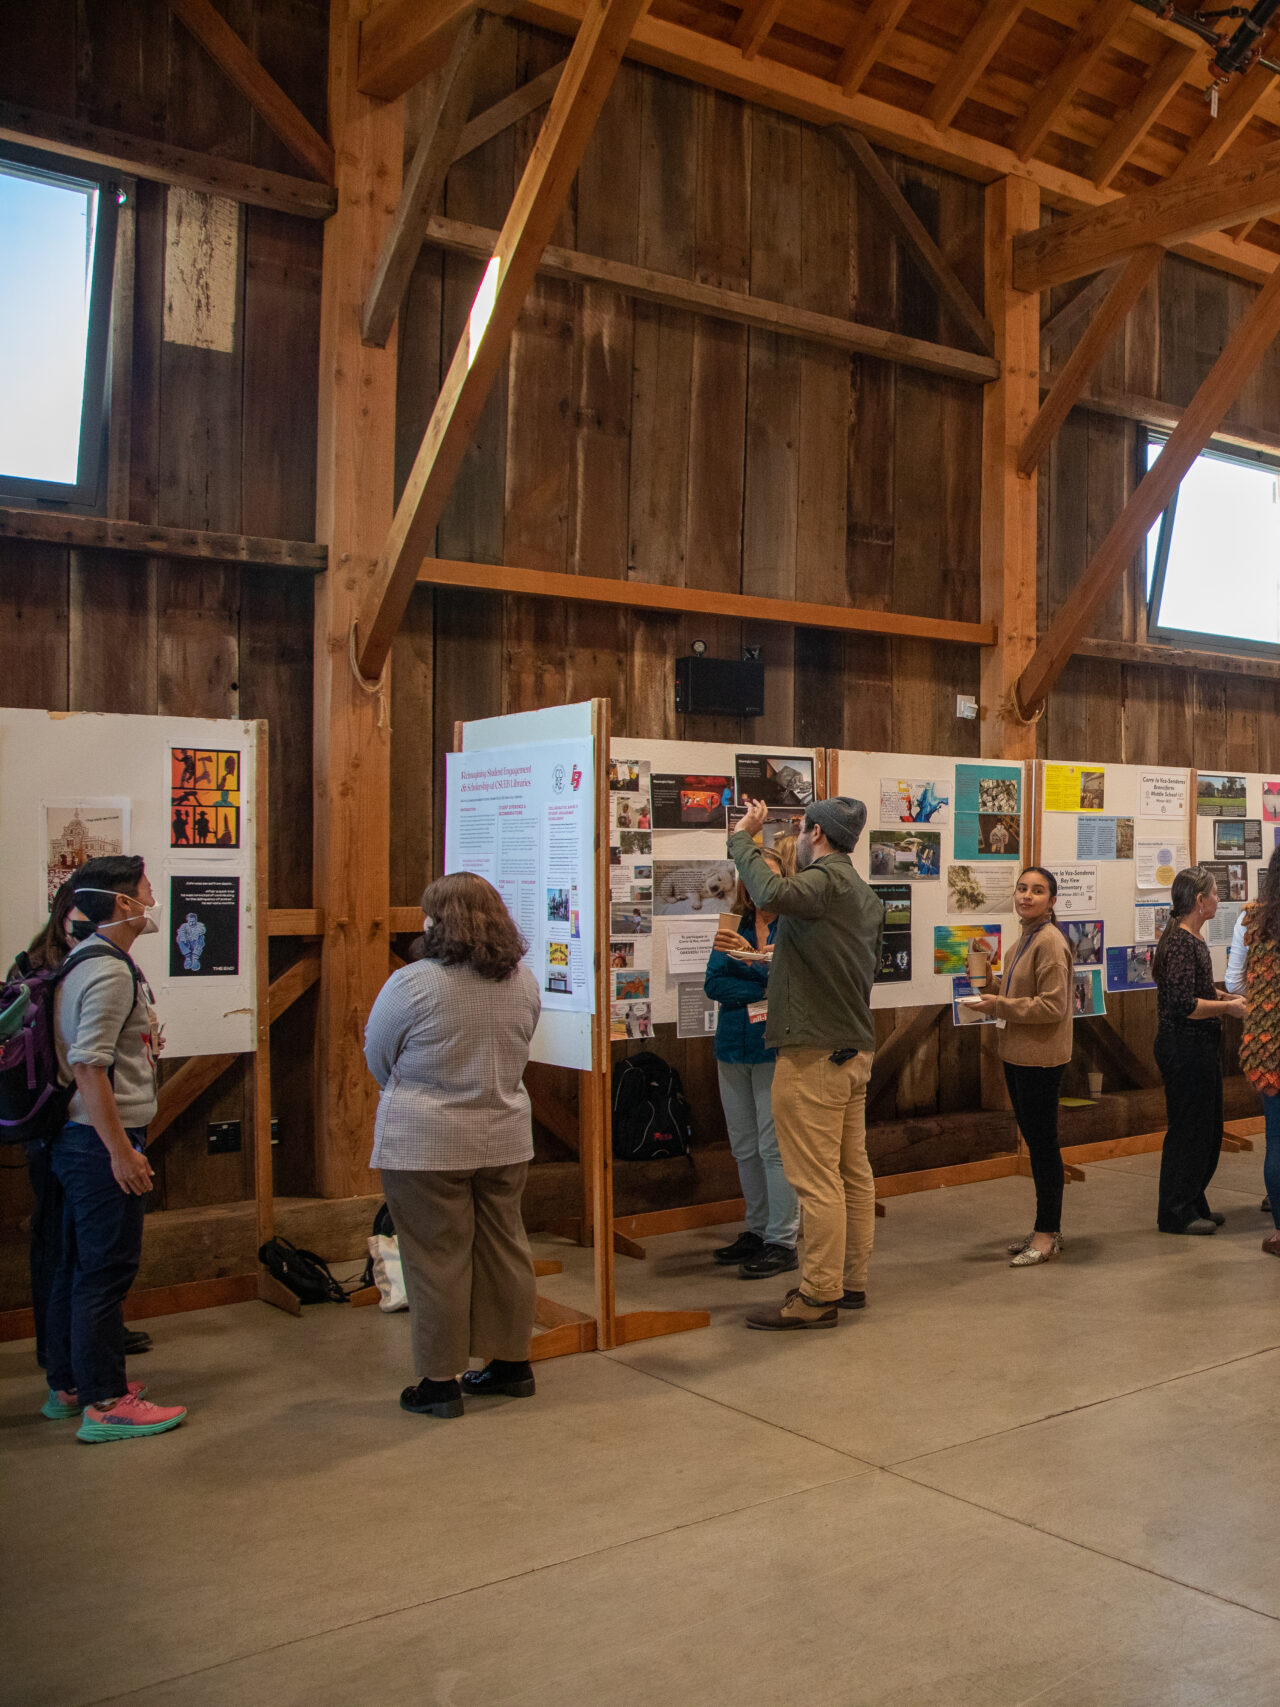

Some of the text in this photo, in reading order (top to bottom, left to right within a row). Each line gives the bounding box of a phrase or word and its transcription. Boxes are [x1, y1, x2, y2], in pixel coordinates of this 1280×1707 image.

[487, 767, 504, 778] Student
[504, 765, 532, 776] Engagement
[511, 779, 531, 788] Libraries
[102, 1414, 134, 1426] HOKA
